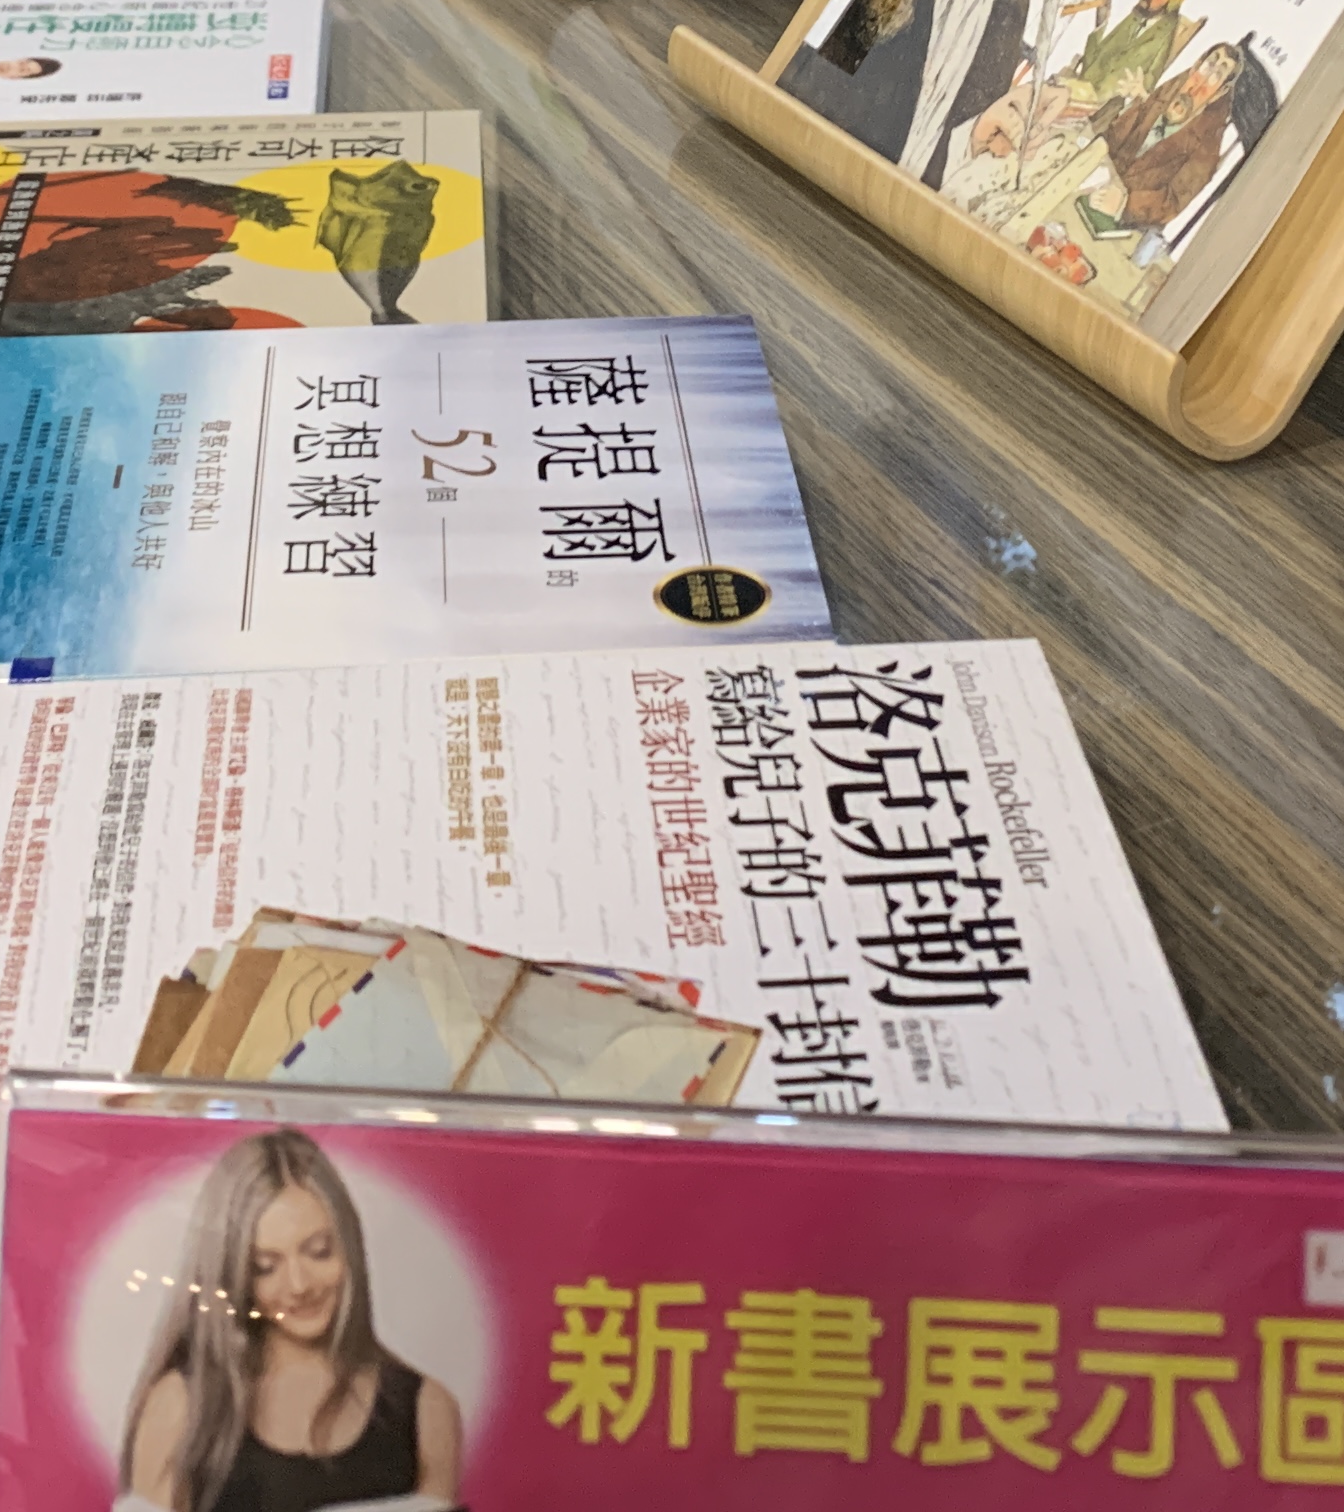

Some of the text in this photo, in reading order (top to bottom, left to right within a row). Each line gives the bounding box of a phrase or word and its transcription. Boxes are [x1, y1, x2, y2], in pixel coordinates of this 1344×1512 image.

[188, 419, 233, 532] 覺察內在的冰山
[282, 373, 382, 579] 冥想練習
[412, 428, 499, 504] 52個
[525, 355, 676, 590] 薩提爾的
[630, 668, 728, 951] 企業家的世紀聖經
[706, 664, 881, 1116] 寫給兒子的三十封信
[794, 660, 1032, 1011] 洛克菲勒
[984, 760, 1051, 890] Rockefeller
